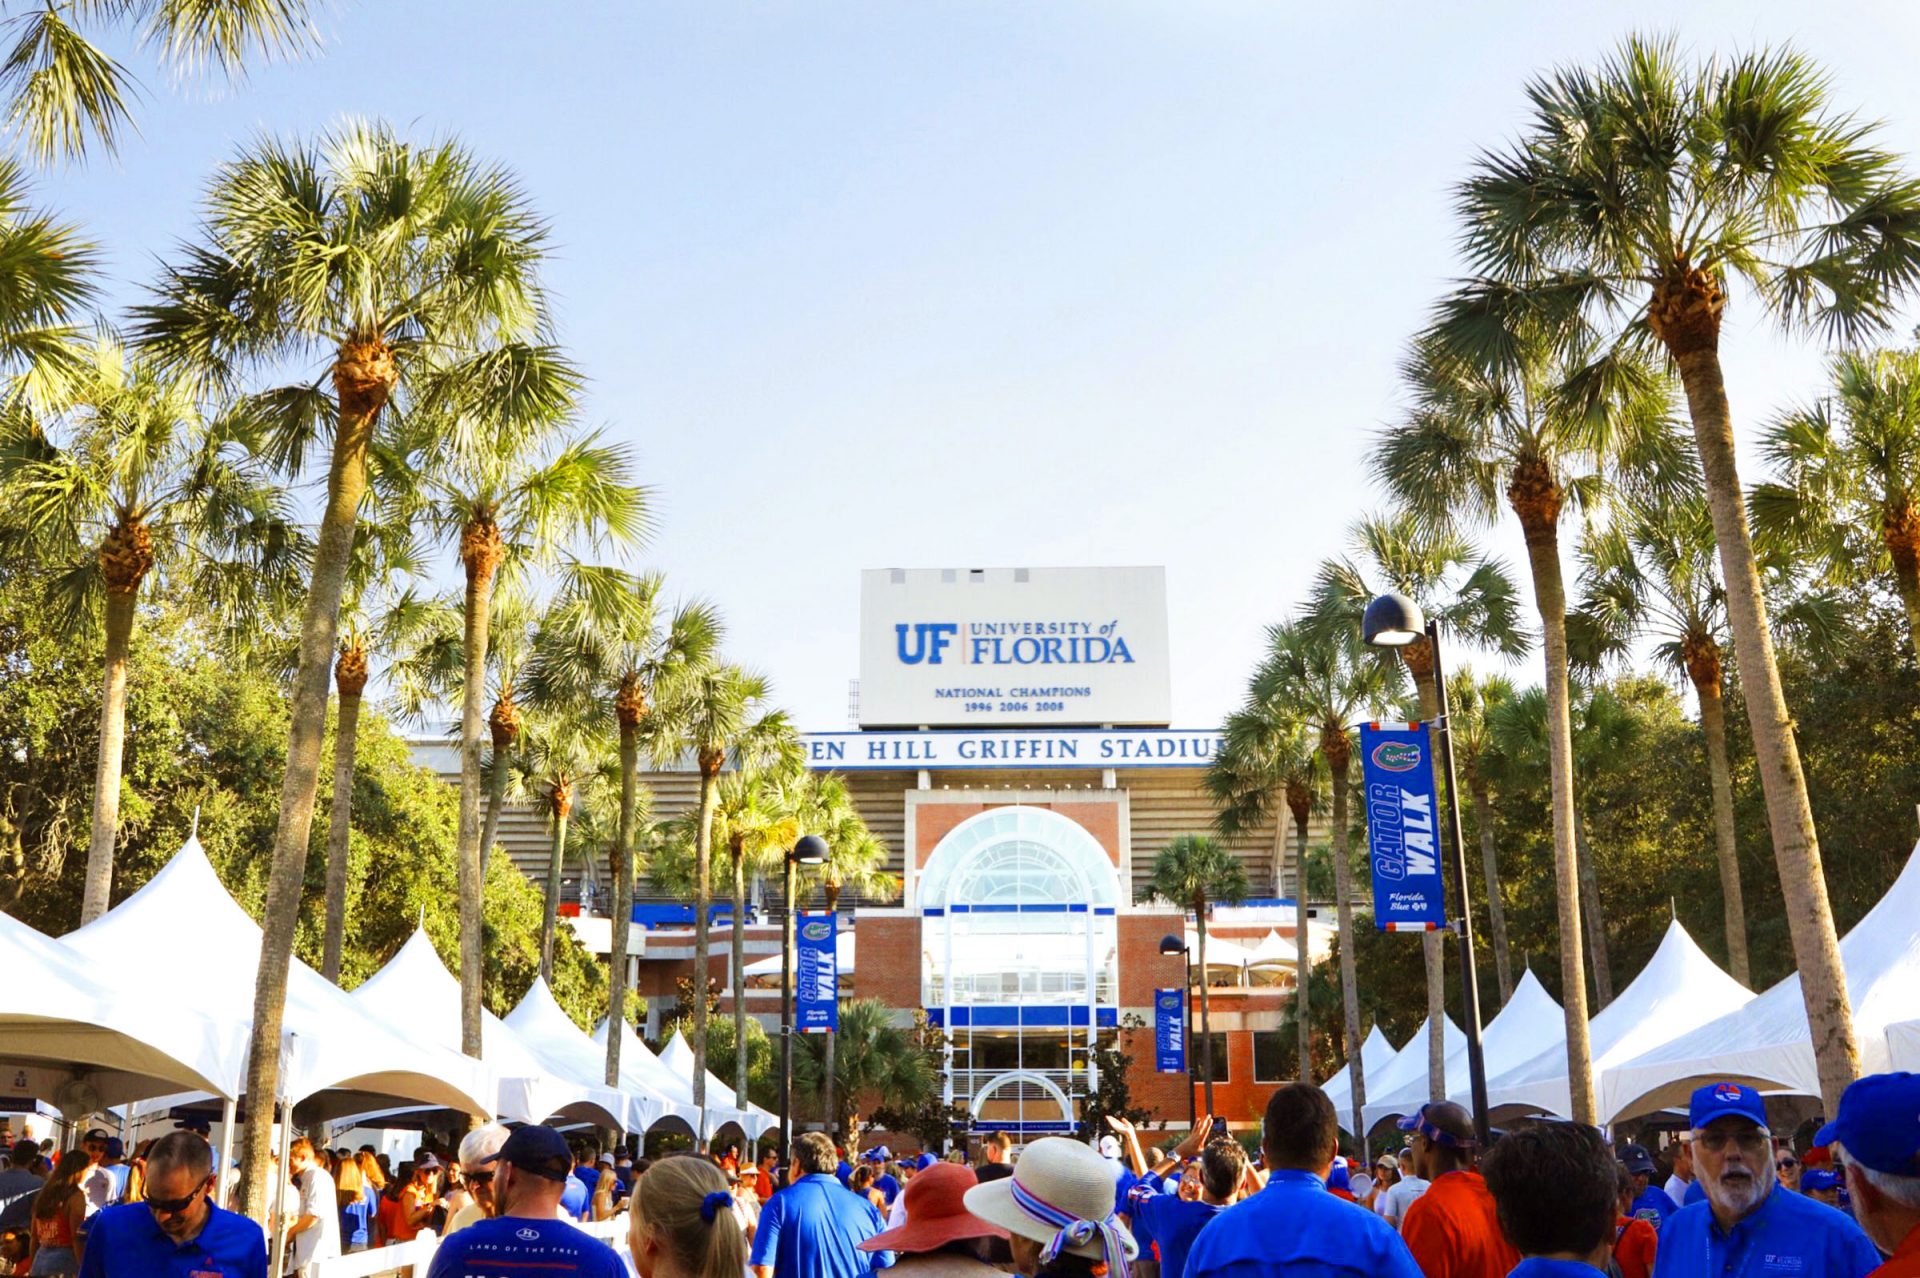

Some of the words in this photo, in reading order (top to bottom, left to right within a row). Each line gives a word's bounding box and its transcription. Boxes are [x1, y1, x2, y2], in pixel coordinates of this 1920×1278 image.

[970, 621, 1092, 635] UNIVERSITY
[1099, 619, 1118, 638] of
[895, 623, 958, 665] UF
[970, 636, 1136, 665] FLORIDA
[935, 688, 1003, 698] NATIONAL
[1009, 687, 1091, 697] CHAMPIONS
[964, 702, 993, 712] 1996
[999, 702, 1028, 712] 2006
[797, 740, 846, 760] EN
[867, 740, 938, 760] HILL
[957, 739, 1079, 760] GRIFFIN
[1370, 783, 1405, 881] GATOR
[1401, 789, 1436, 875] WALK
[1389, 892, 1425, 901] Florida
[1390, 902, 1410, 911] Blue
[799, 946, 817, 1004] GATOR
[817, 949, 835, 1001] WALK
[1169, 1015, 1182, 1051] WALK
[552, 1247, 579, 1256] FREE
